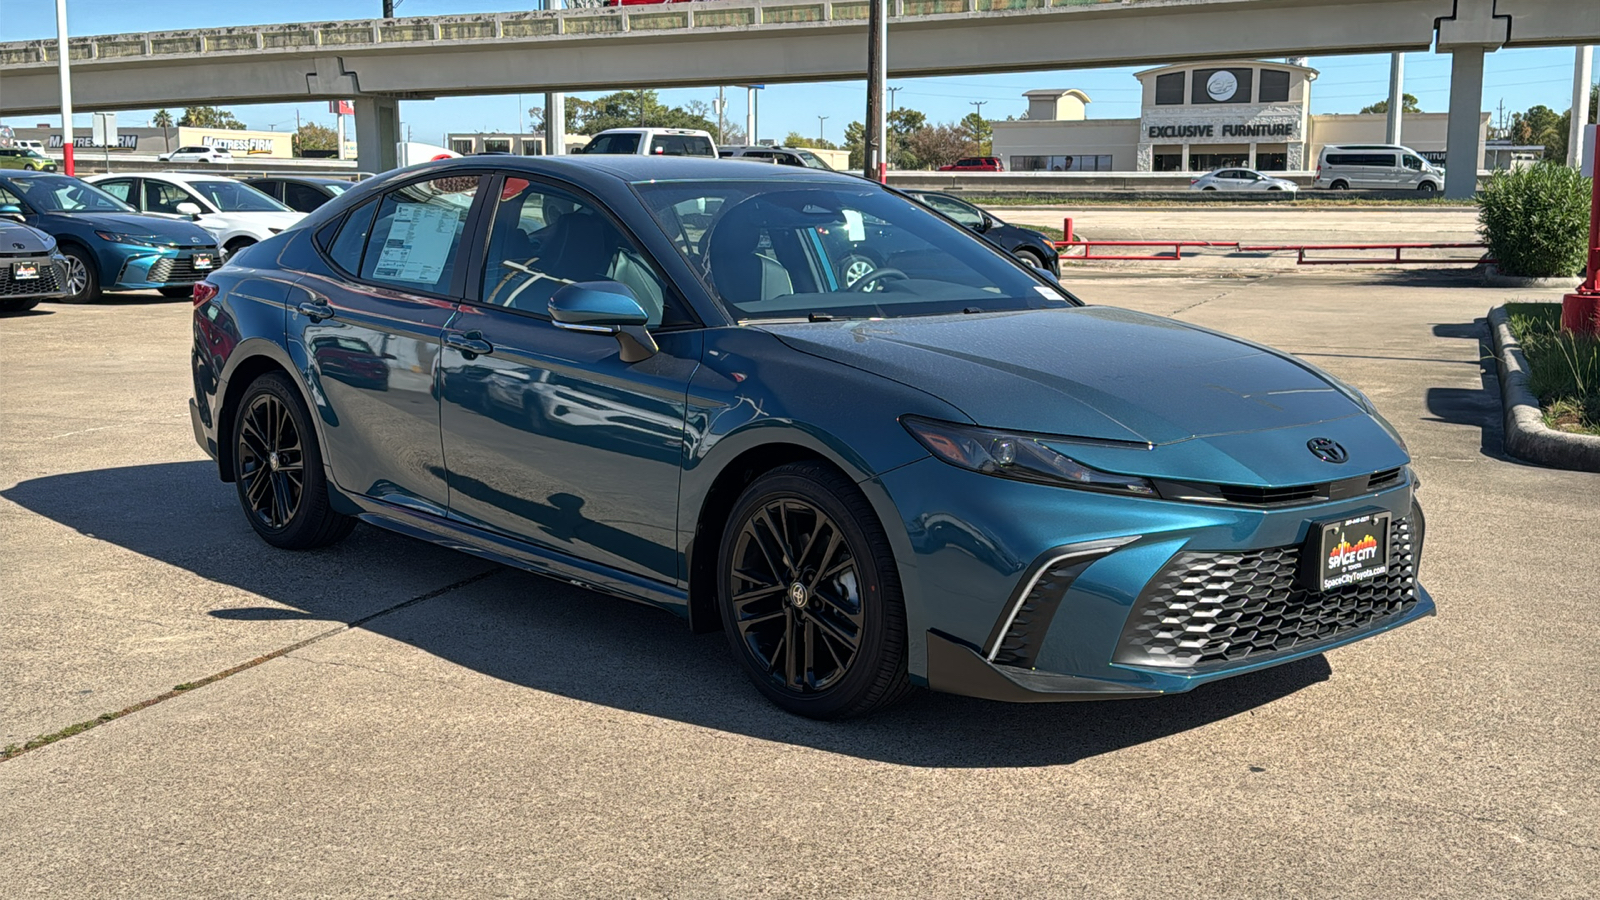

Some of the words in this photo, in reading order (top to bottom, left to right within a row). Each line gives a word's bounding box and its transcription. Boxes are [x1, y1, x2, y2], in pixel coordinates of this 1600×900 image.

[1148, 124, 1214, 138] EXCLUSIVE
[1221, 123, 1293, 137] FURNITURE
[1328, 551, 1357, 569] SPACE
[1357, 545, 1377, 561] CITY
[1324, 566, 1386, 589] SpaceCityToyota.com
